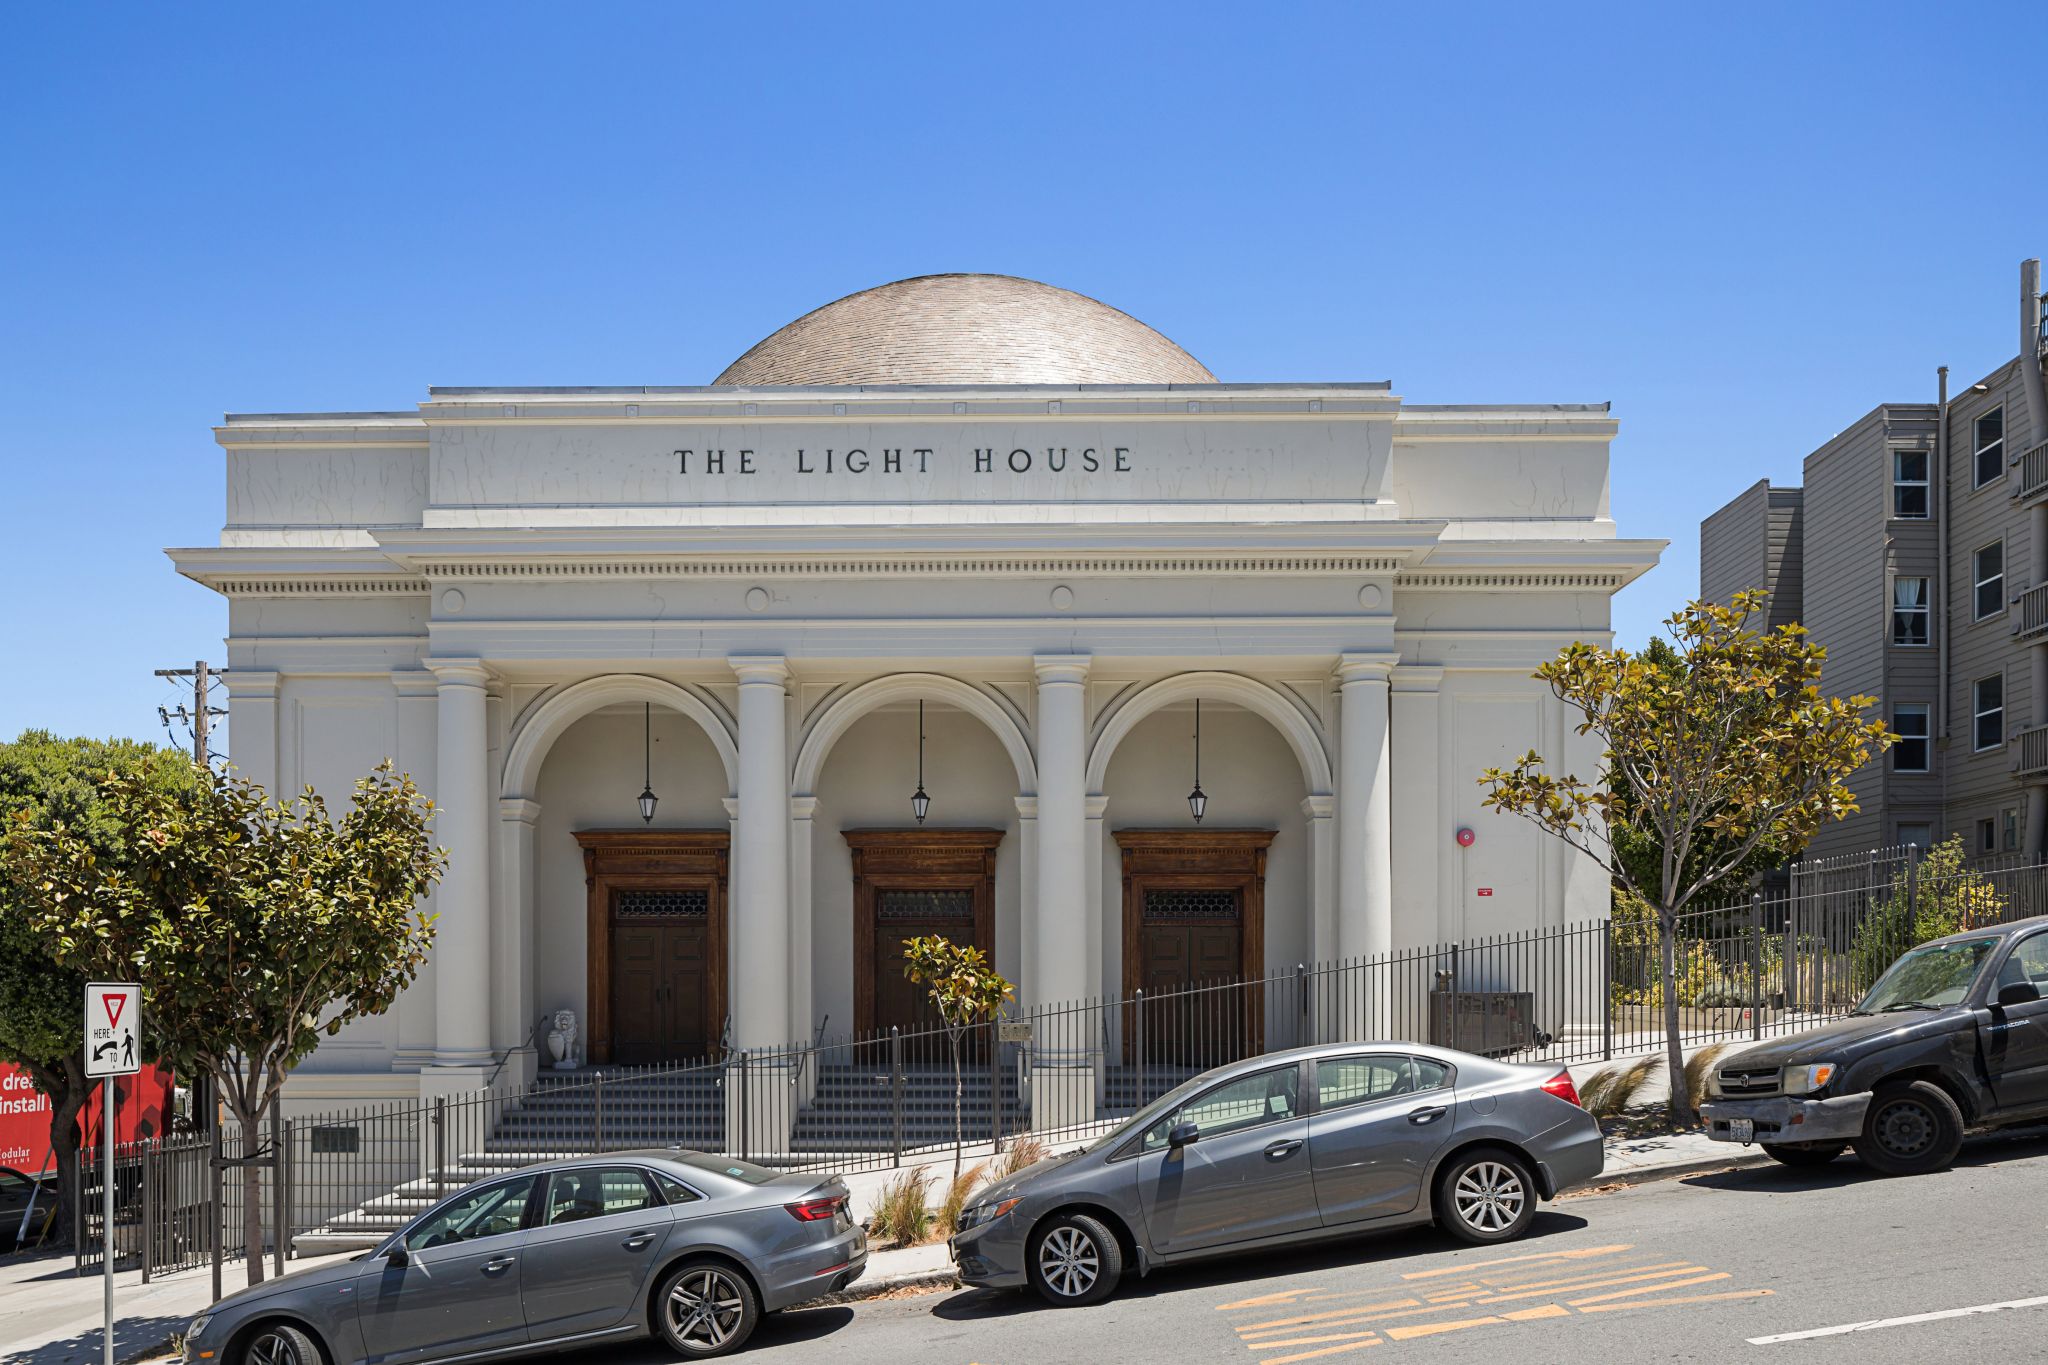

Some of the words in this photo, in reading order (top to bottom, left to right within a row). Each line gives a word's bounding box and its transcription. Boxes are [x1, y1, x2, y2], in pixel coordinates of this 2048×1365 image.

[673, 449, 756, 474] THE
[797, 448, 933, 474] LIGHT
[974, 448, 1131, 473] HOUSE
[93, 1028, 111, 1039] HERE
[110, 1052, 118, 1063] TO
